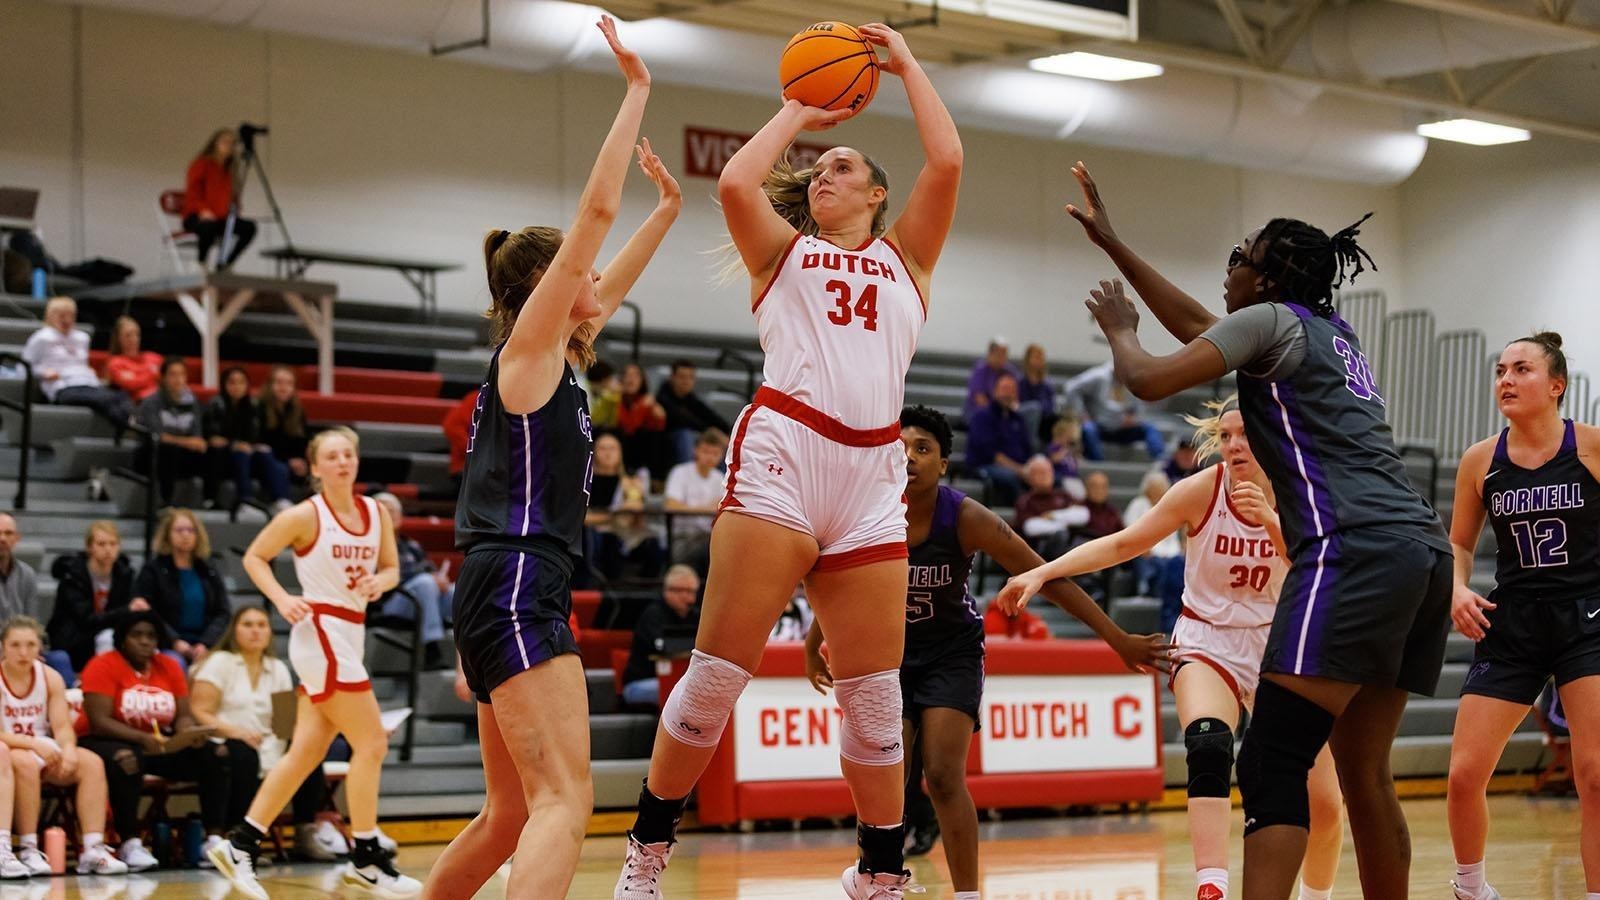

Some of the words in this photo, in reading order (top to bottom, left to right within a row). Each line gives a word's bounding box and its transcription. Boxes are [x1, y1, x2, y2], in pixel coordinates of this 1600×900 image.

[801, 252, 897, 283] DUTCH
[825, 279, 878, 332] 34
[1332, 335, 1386, 408] 3
[1491, 483, 1585, 517] CORNELL
[1214, 534, 1280, 559] DUTC
[1510, 517, 1569, 569] 12
[1229, 564, 1271, 593] 30
[904, 591, 934, 624] 5
[989, 702, 1088, 740] DUTCH
[1113, 694, 1142, 739] C
